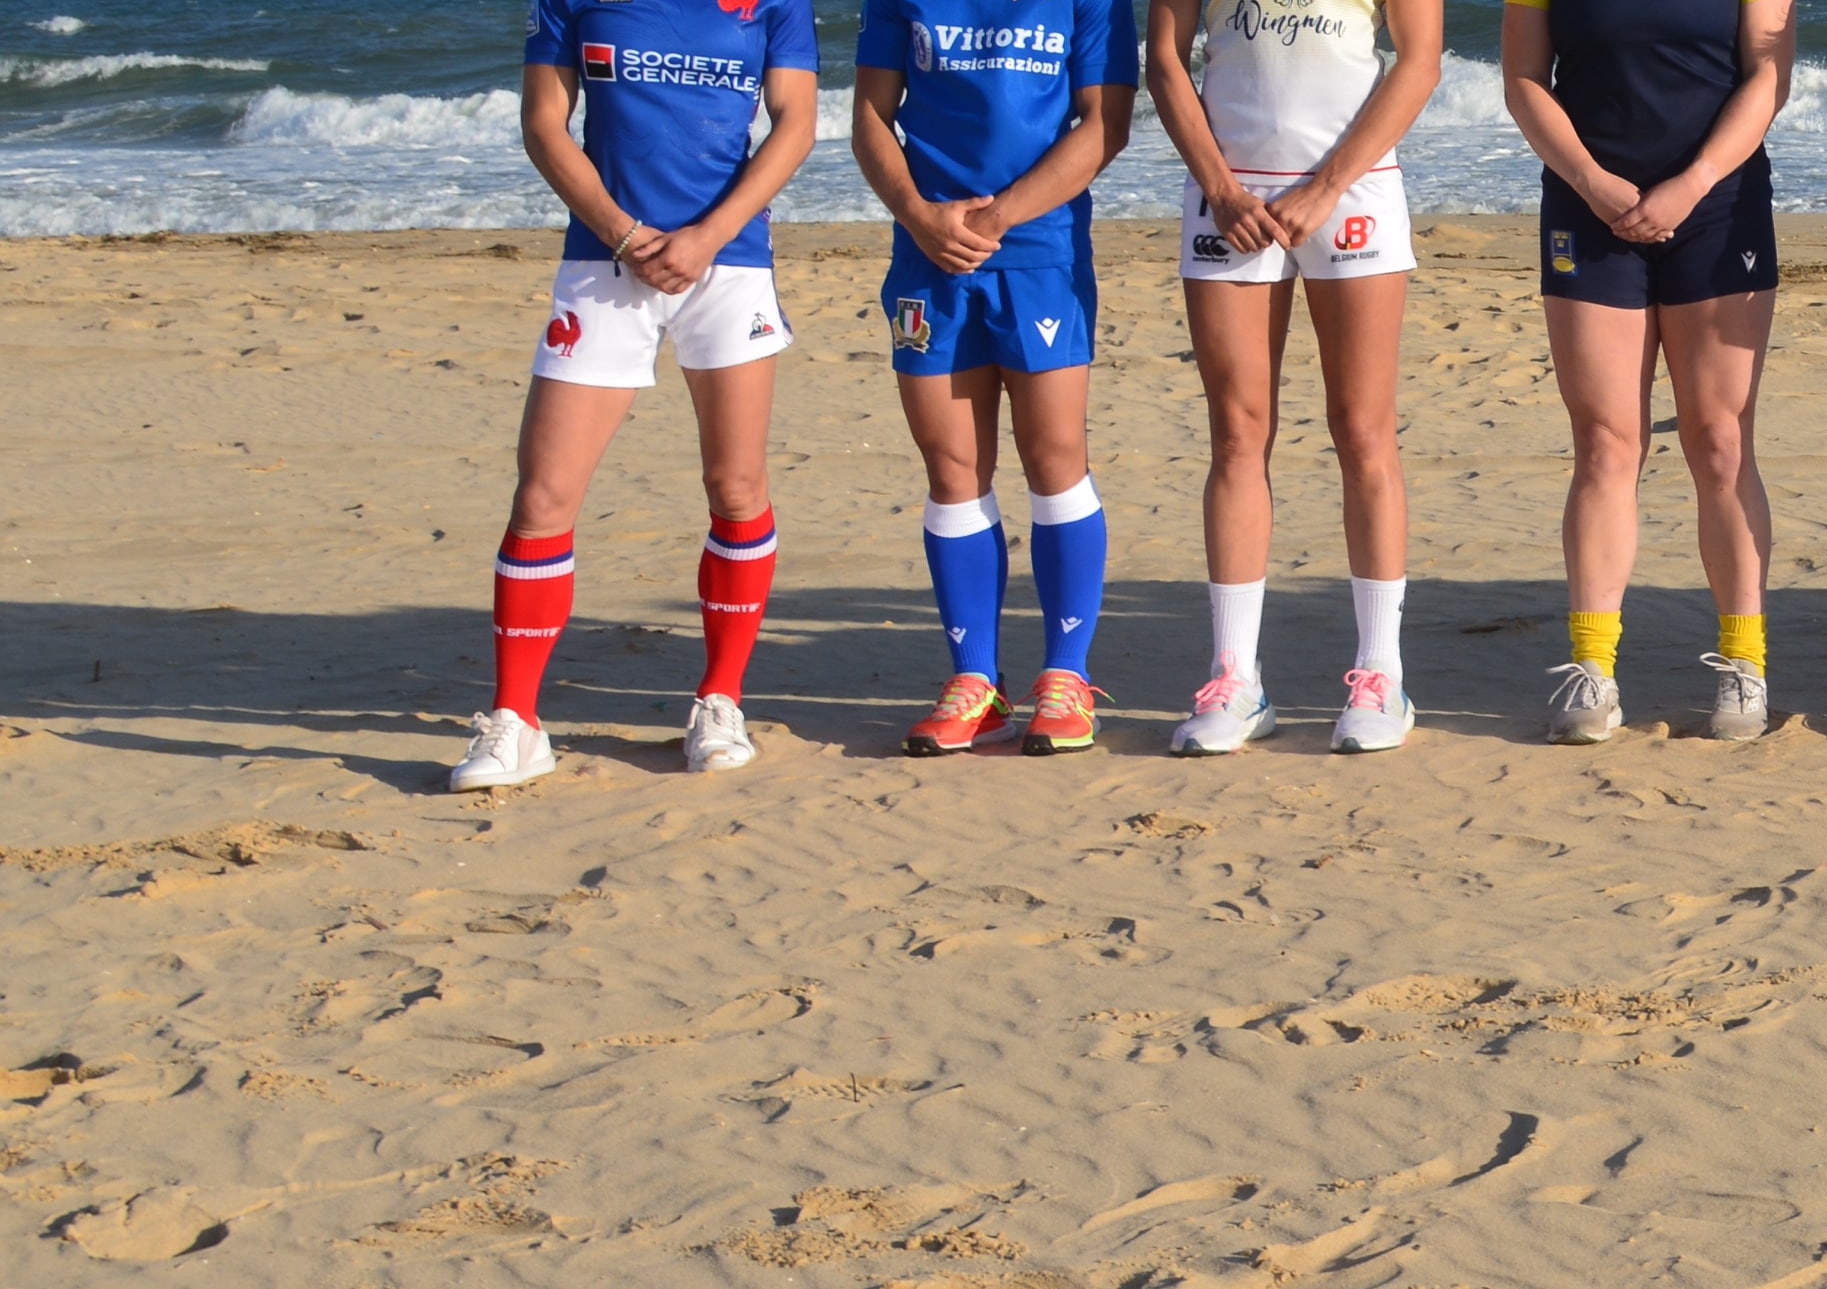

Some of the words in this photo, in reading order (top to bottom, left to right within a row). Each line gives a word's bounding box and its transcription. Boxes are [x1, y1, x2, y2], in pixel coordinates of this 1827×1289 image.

[1226, 0, 1347, 46] Wingmen
[934, 24, 1065, 54] Vittoria
[622, 49, 744, 75] SOCIETE
[939, 56, 1061, 76] Assicurazioni
[622, 67, 757, 92] GENERALE
[707, 602, 761, 613] SPORTIF
[506, 626, 561, 638] SPORTIF
